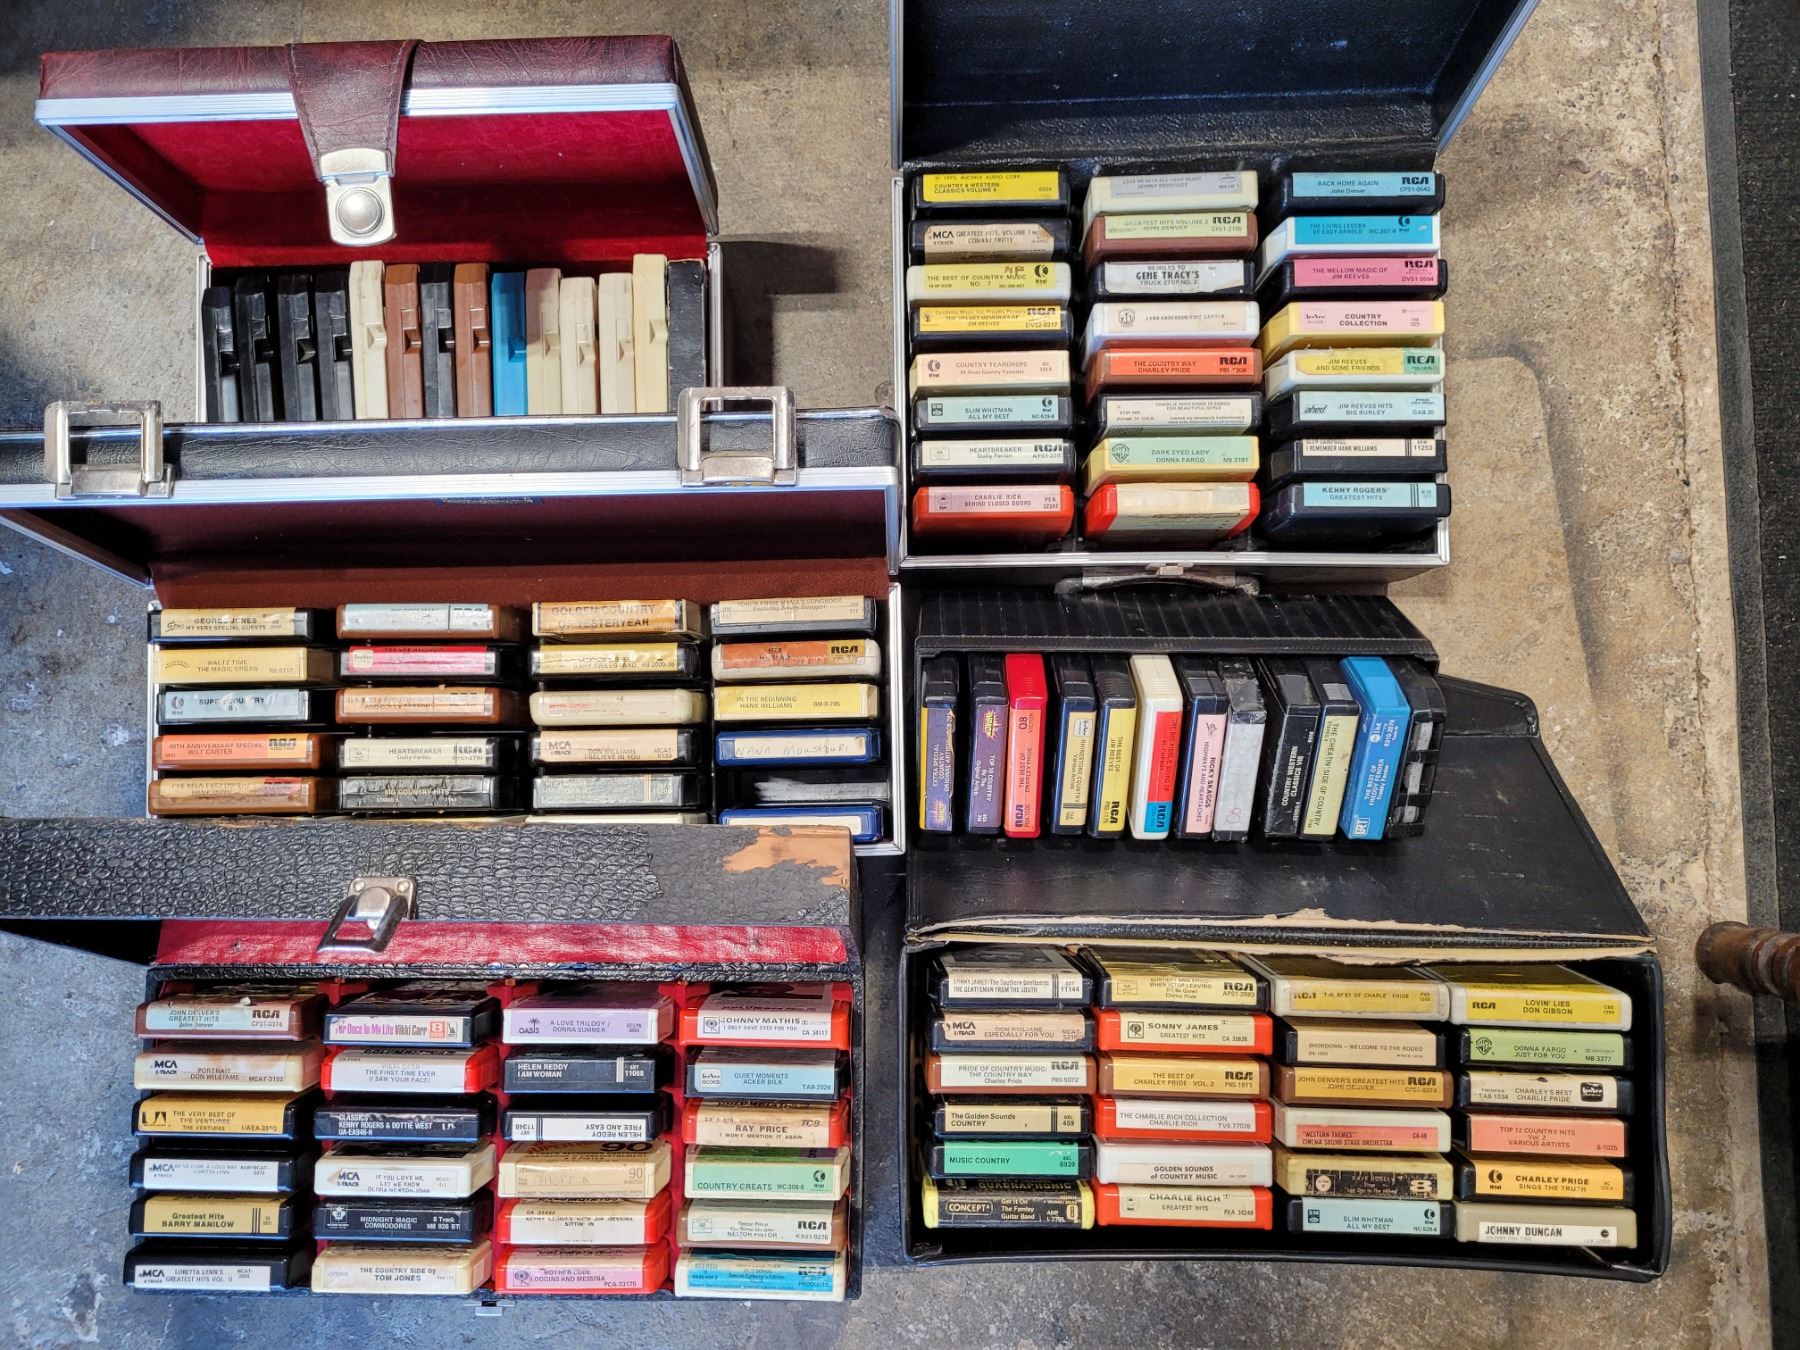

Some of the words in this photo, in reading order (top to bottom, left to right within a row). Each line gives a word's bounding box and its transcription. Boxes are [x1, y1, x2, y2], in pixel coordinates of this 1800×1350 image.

[1402, 176, 1429, 185] RCA
[1212, 216, 1241, 224] RCA
[933, 230, 954, 239] MCA
[1136, 271, 1158, 280] GENE
[1162, 270, 1200, 279] TRACY'S
[1219, 357, 1247, 365] RCA
[1406, 355, 1435, 364] RCA
[831, 645, 858, 654] RCA
[1018, 716, 1028, 730] Q8
[548, 741, 571, 750] MCA
[1286, 745, 1299, 776] WESTERN
[1369, 764, 1376, 773] OF
[1374, 758, 1384, 782] FENDER
[1205, 779, 1214, 808] SKAGGS
[1281, 776, 1292, 806] COUNTRY
[1370, 782, 1380, 806] FREDDY
[1014, 804, 1024, 828] RCA
[1110, 801, 1120, 824] RCA
[1156, 804, 1166, 828] RCA
[1224, 982, 1254, 992] RCA
[252, 1010, 280, 1019] RCA
[1542, 1007, 1573, 1015] GIBSON
[154, 1060, 178, 1068] MCA
[1408, 1077, 1437, 1086] RCA
[735, 1124, 754, 1132] RAY
[760, 1125, 788, 1133] PRICE
[599, 1141, 653, 1152] 90
[152, 1163, 175, 1172] MCA
[1515, 1175, 1559, 1184] CHARLEY
[1561, 1177, 1590, 1185] PRIDE
[1149, 1193, 1193, 1202] CHARLIE
[1196, 1194, 1221, 1203] RICH
[798, 1220, 827, 1230] RCA
[1485, 1225, 1521, 1236] JOHNNY
[1524, 1227, 1563, 1237] DUNCAN
[142, 1269, 165, 1278] MCA
